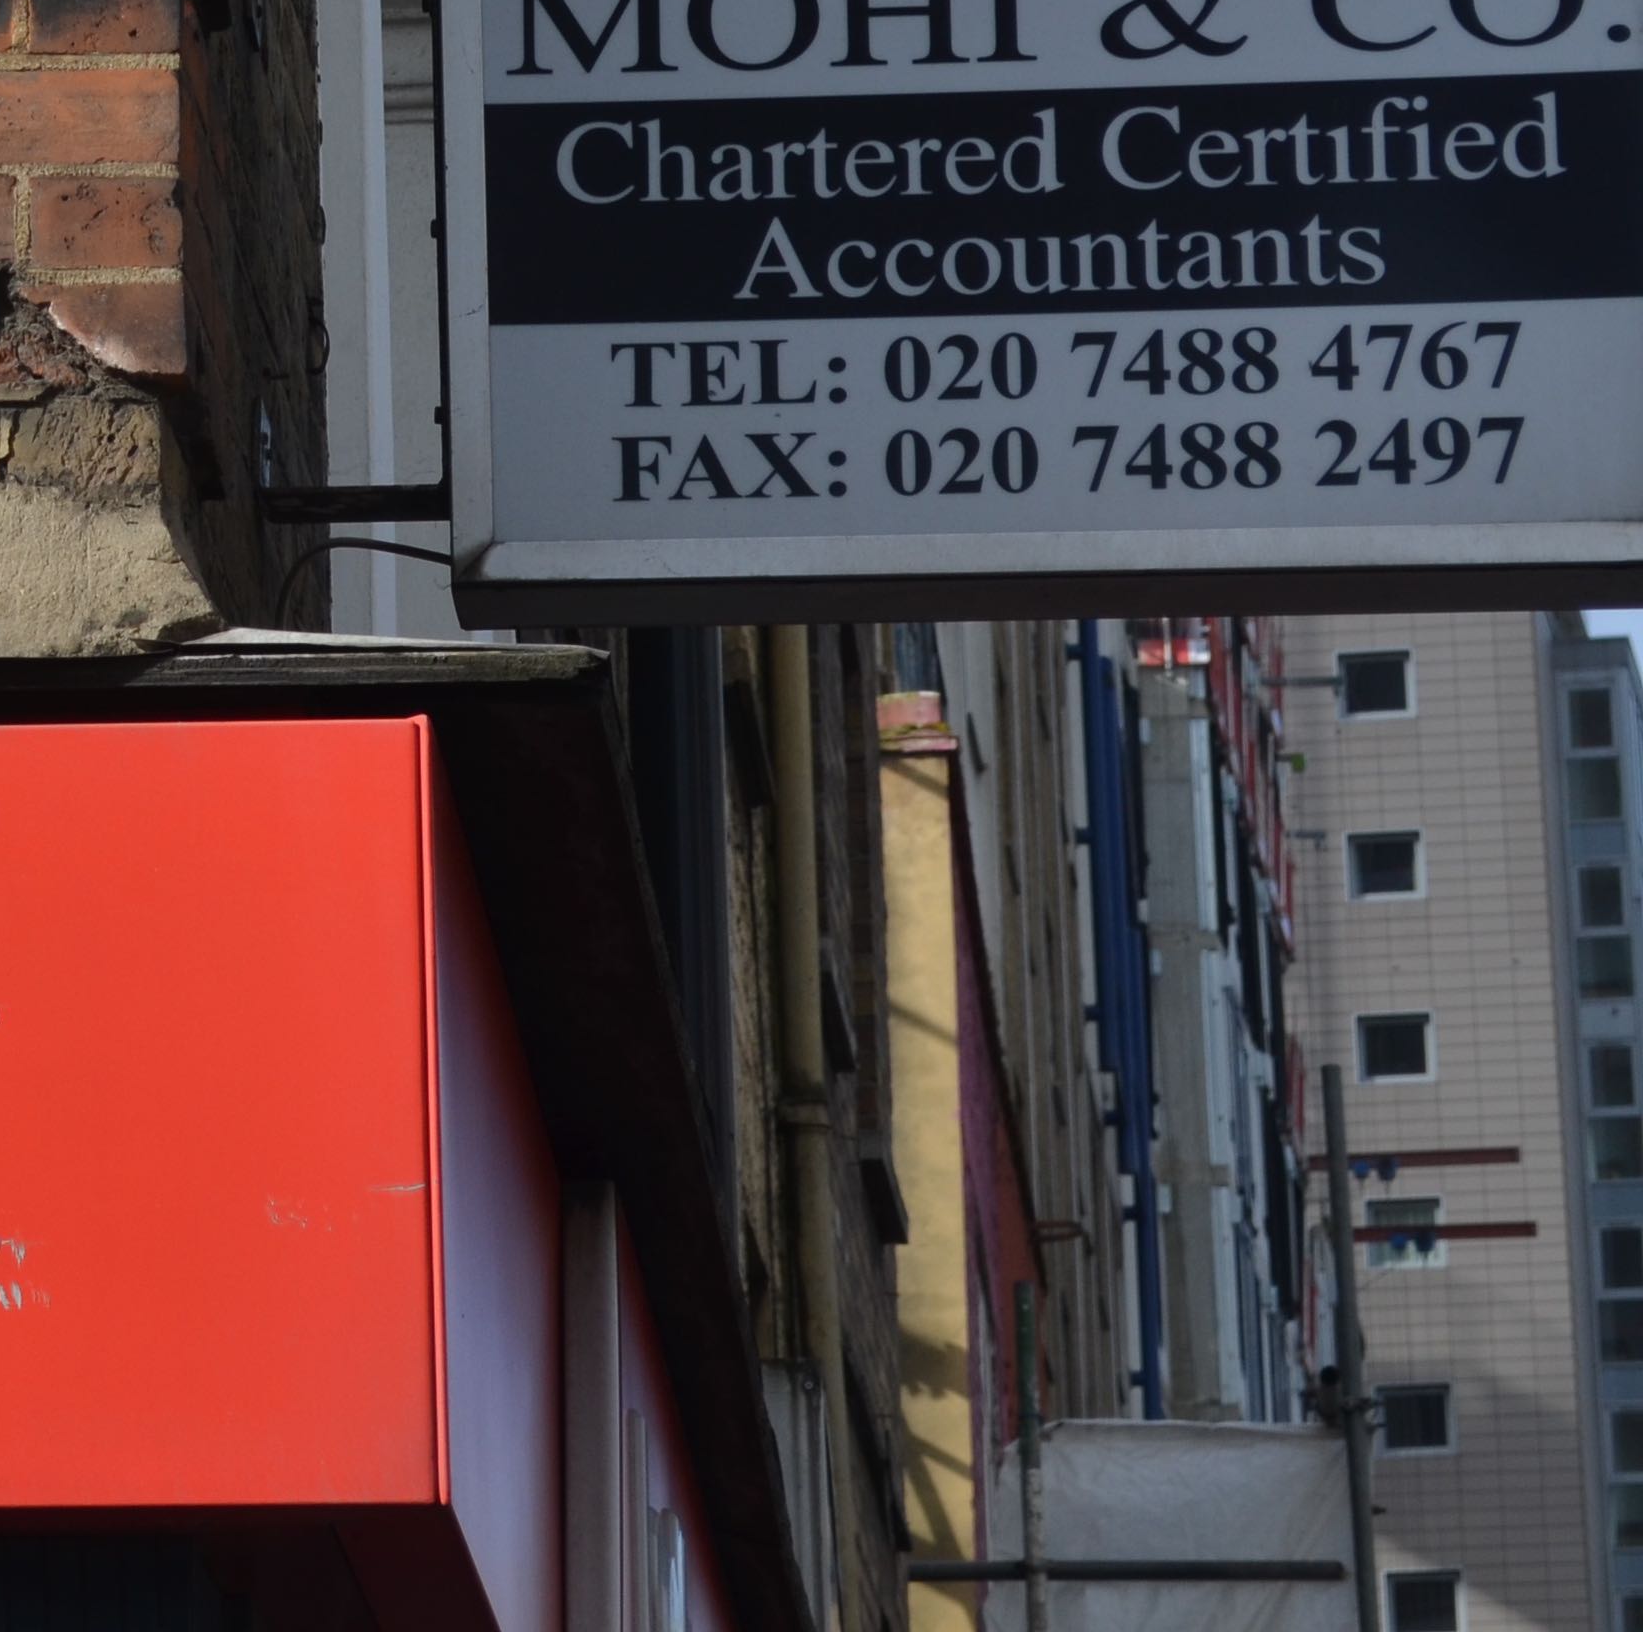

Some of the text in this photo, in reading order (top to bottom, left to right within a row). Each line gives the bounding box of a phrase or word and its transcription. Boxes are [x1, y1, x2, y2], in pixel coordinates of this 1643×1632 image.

[557, 92, 1565, 203] Chartered Certified
[734, 215, 1388, 300] Accountants
[611, 321, 1522, 408] TEL: 020 7488 4767
[612, 416, 1525, 502] FAX: 020 7488 2497
